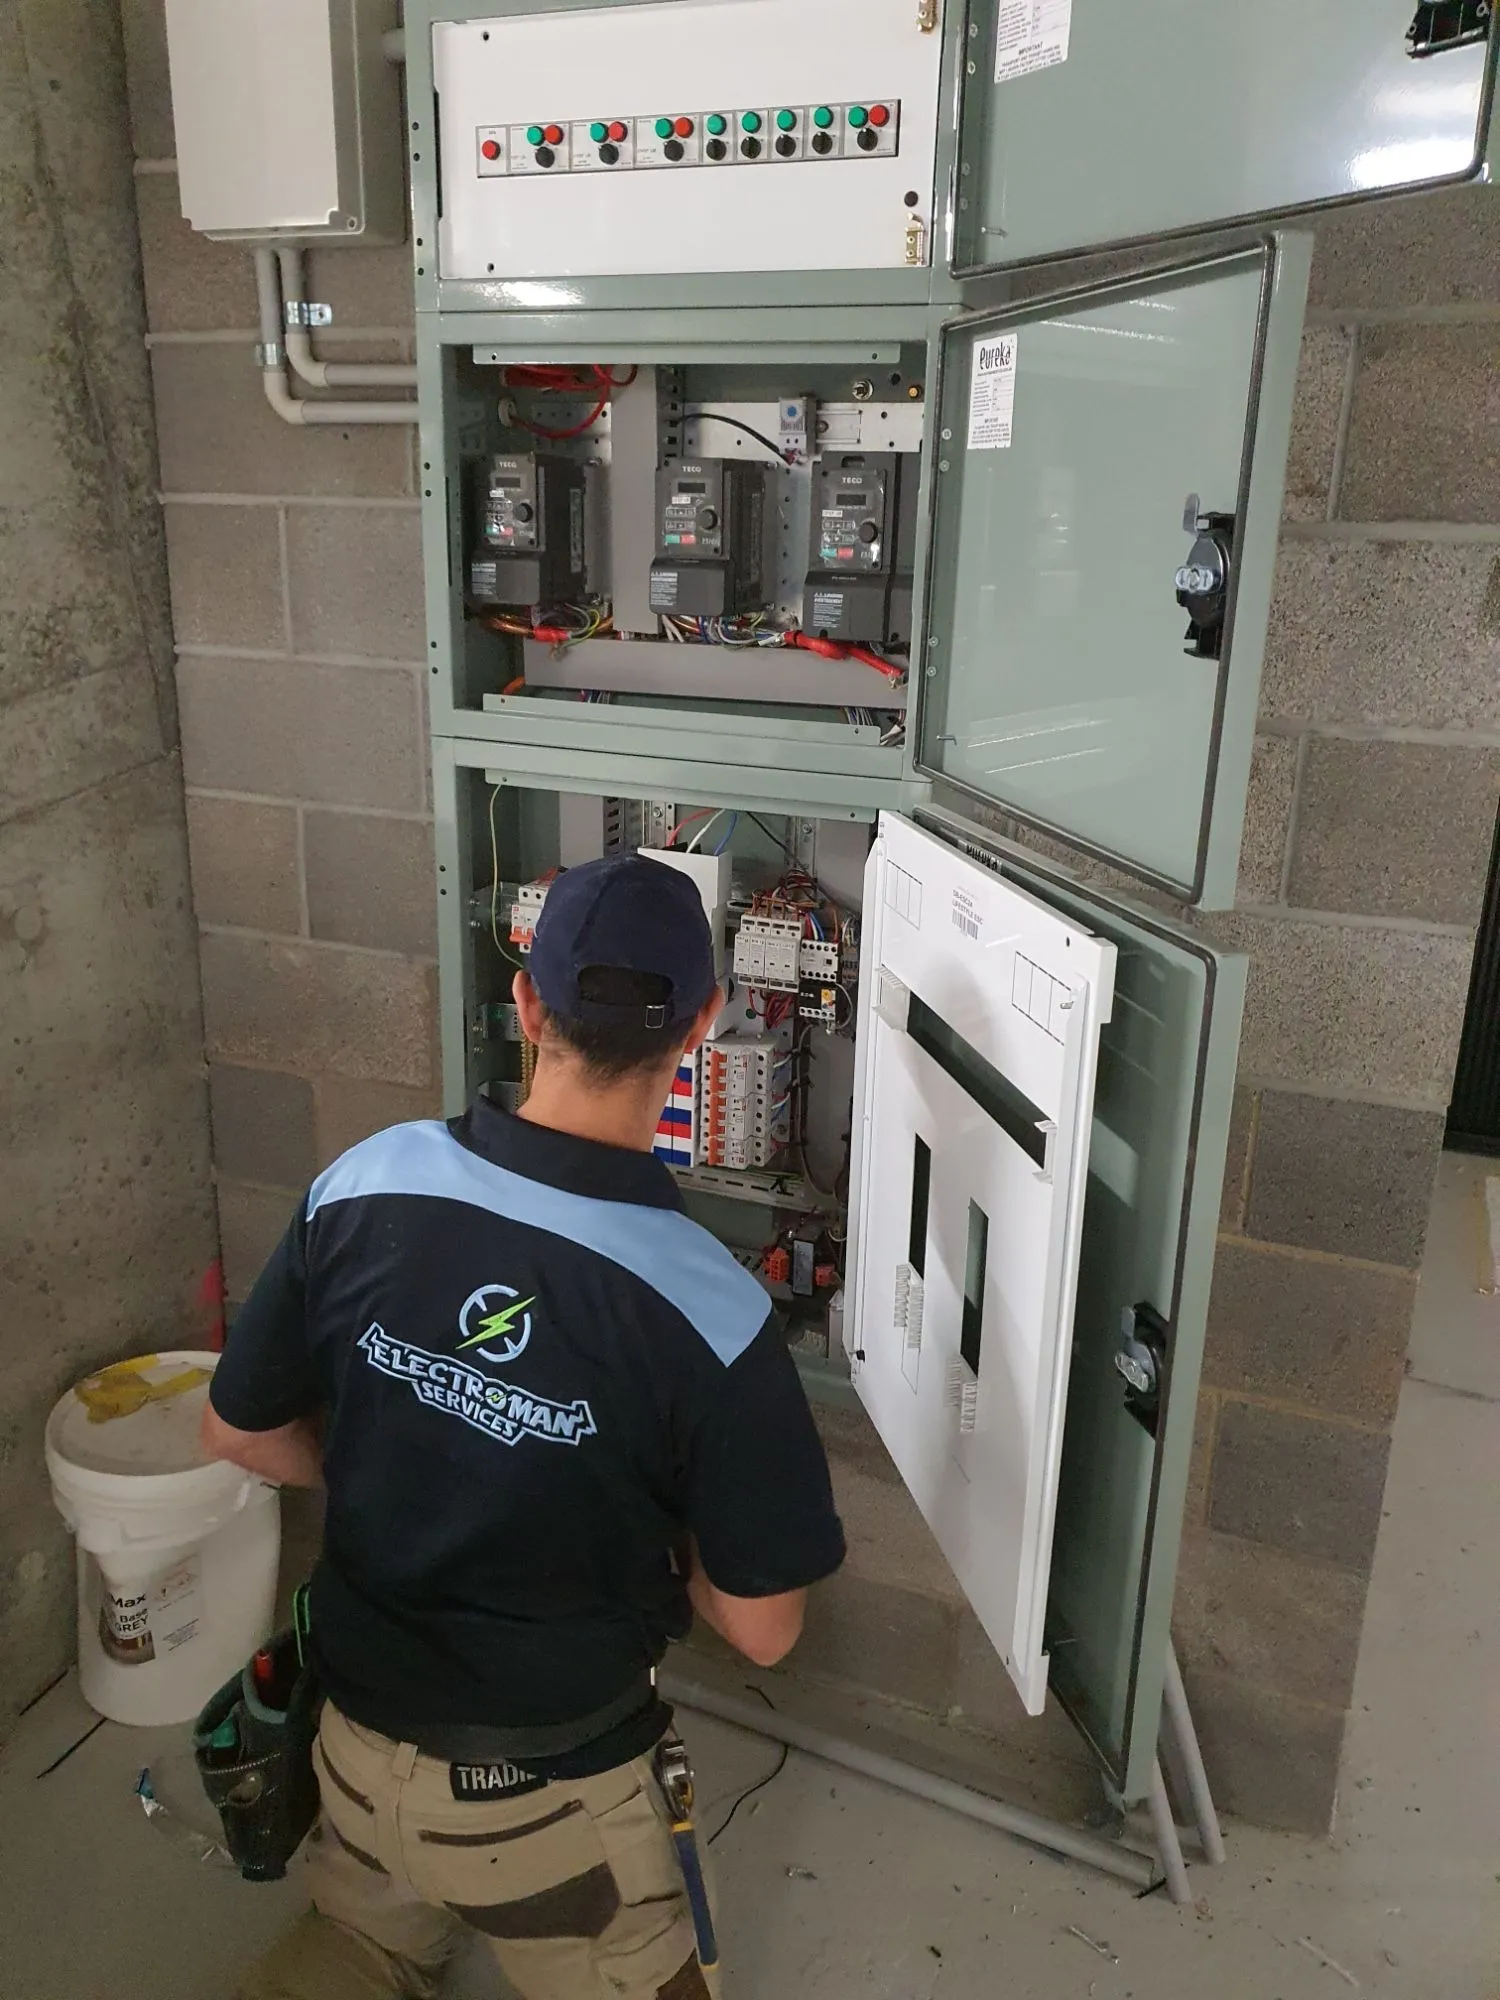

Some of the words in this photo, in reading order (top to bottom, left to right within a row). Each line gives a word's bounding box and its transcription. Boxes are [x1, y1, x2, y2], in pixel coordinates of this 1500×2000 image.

[980, 341, 1011, 370] eureka
[682, 465, 701, 473] TECO
[842, 476, 862, 484] TECO
[370, 1331, 584, 1437] ELECTROMAN
[422, 1382, 518, 1437] SERVICES
[119, 1608, 148, 1623] Base
